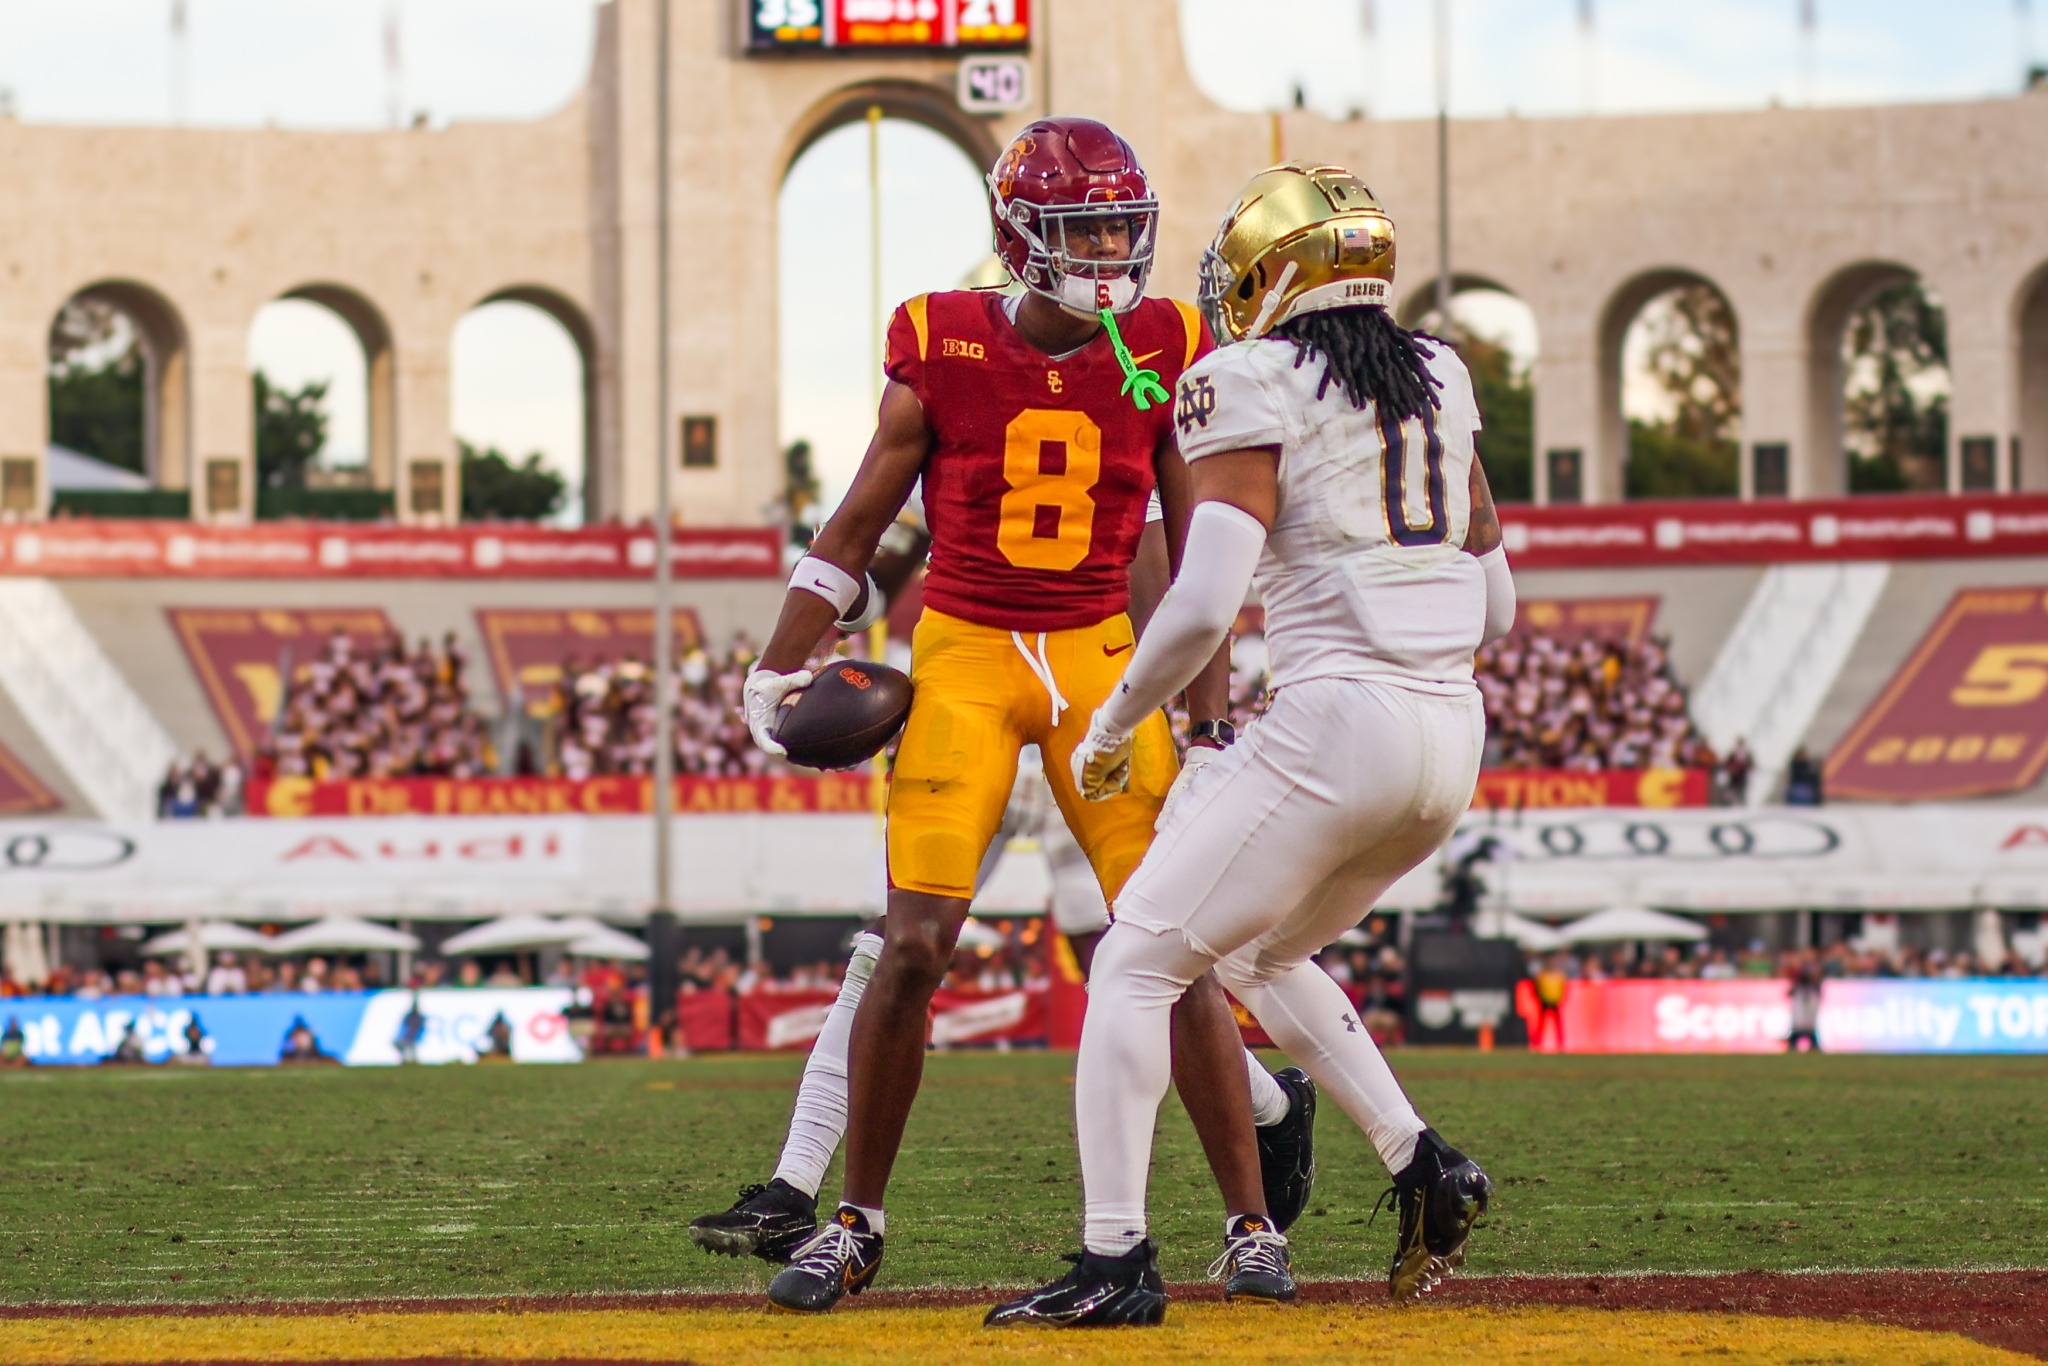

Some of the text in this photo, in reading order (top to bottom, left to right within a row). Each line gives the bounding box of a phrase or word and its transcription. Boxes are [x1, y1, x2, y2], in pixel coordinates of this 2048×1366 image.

[1345, 283, 1385, 297] IRISH
[1374, 398, 1451, 547] 0
[997, 408, 1101, 571] 8
[1866, 735, 2027, 764] 2005
[278, 832, 560, 861] Audi
